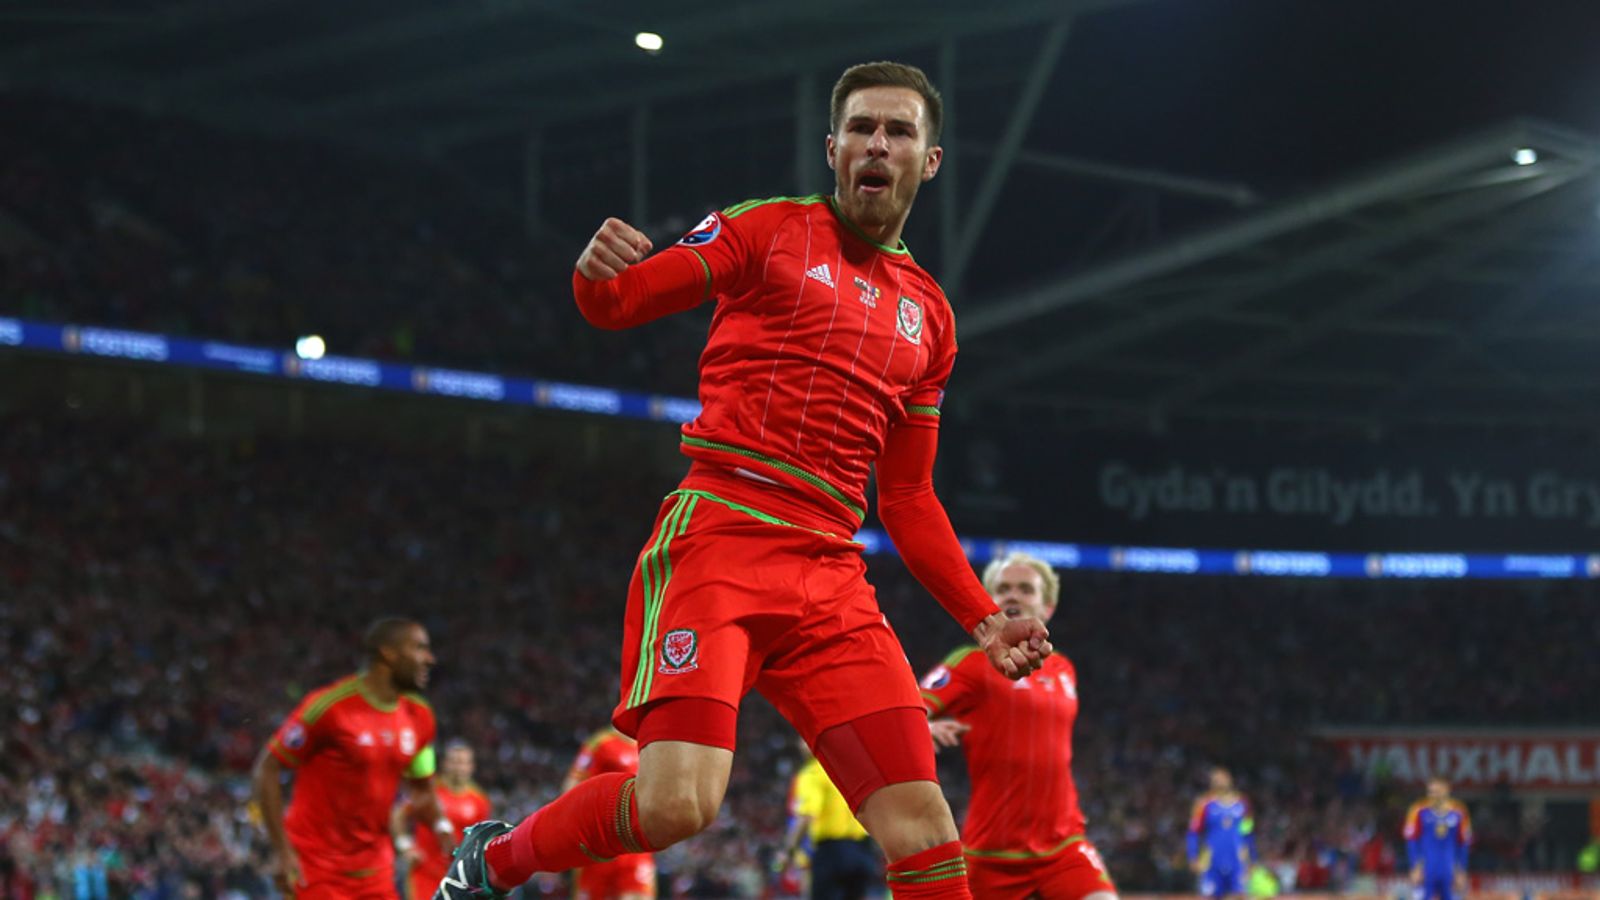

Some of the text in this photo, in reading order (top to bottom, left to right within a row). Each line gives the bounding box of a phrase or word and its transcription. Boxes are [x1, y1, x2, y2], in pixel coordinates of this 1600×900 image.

[805, 269, 835, 289] adidas
[1098, 463, 1258, 520] Gyda'n
[1267, 467, 1440, 525] Gilydd.
[1450, 471, 1516, 517] Yn
[1348, 743, 1600, 784] VAUXHAL
